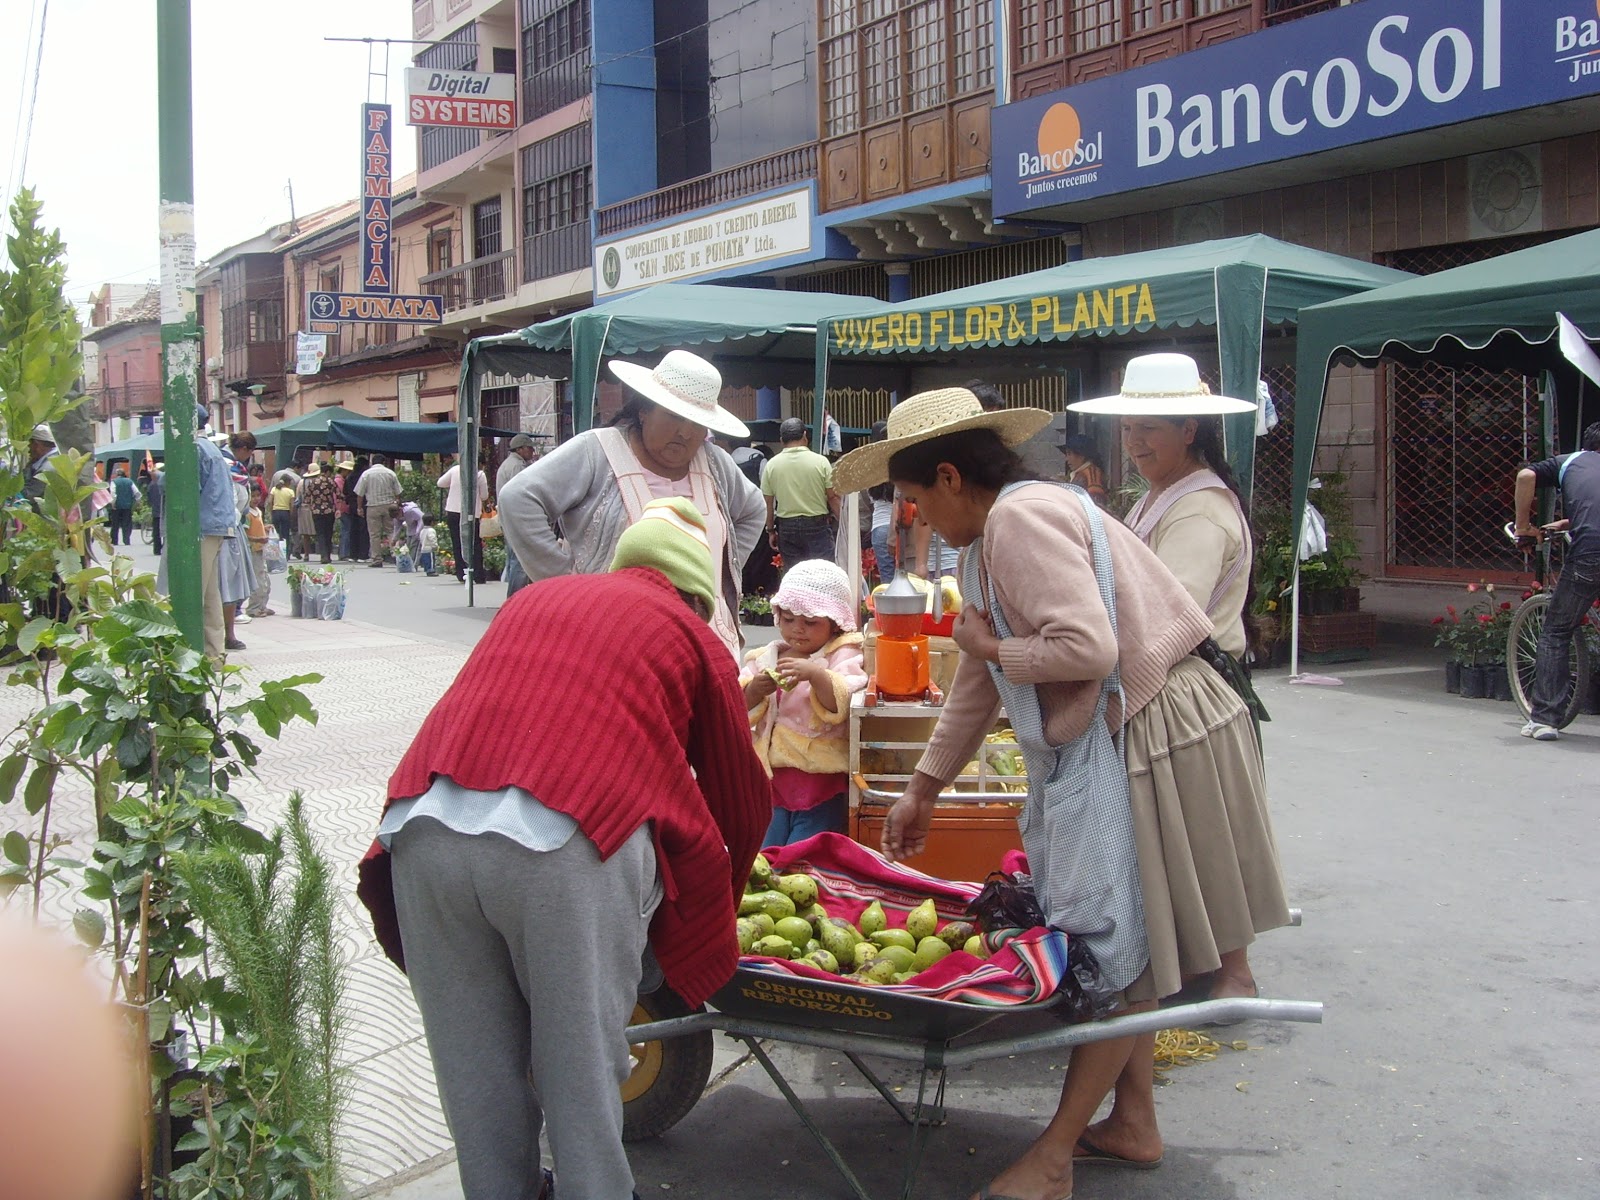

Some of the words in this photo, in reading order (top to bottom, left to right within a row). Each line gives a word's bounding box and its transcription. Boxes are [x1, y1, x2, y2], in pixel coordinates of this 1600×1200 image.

[427, 73, 491, 97] Digital
[1135, 0, 1501, 168] BancoSol
[411, 99, 511, 125] SYSTEMS
[1018, 131, 1102, 177] BancoSol
[365, 110, 390, 287] FARMACIA
[1026, 180, 1055, 199] Juntos
[1056, 171, 1098, 189] crecemos
[625, 235, 669, 260] COOPERATIVA
[671, 233, 681, 249] DE
[683, 224, 713, 246] AHORRO
[715, 221, 721, 237] Y
[724, 212, 759, 235] CREDITO
[761, 202, 797, 226] ABIERTA
[662, 250, 686, 274] JOSE
[690, 251, 700, 268] DE
[754, 234, 777, 253] Ltda.
[338, 296, 440, 320] PUNATA
[833, 312, 923, 350] VIVERO
[929, 304, 1003, 346] FLOR
[1031, 283, 1157, 335] PLANTA
[740, 987, 893, 1021] REFORZADO
[753, 980, 876, 1008] ORIGINAL
